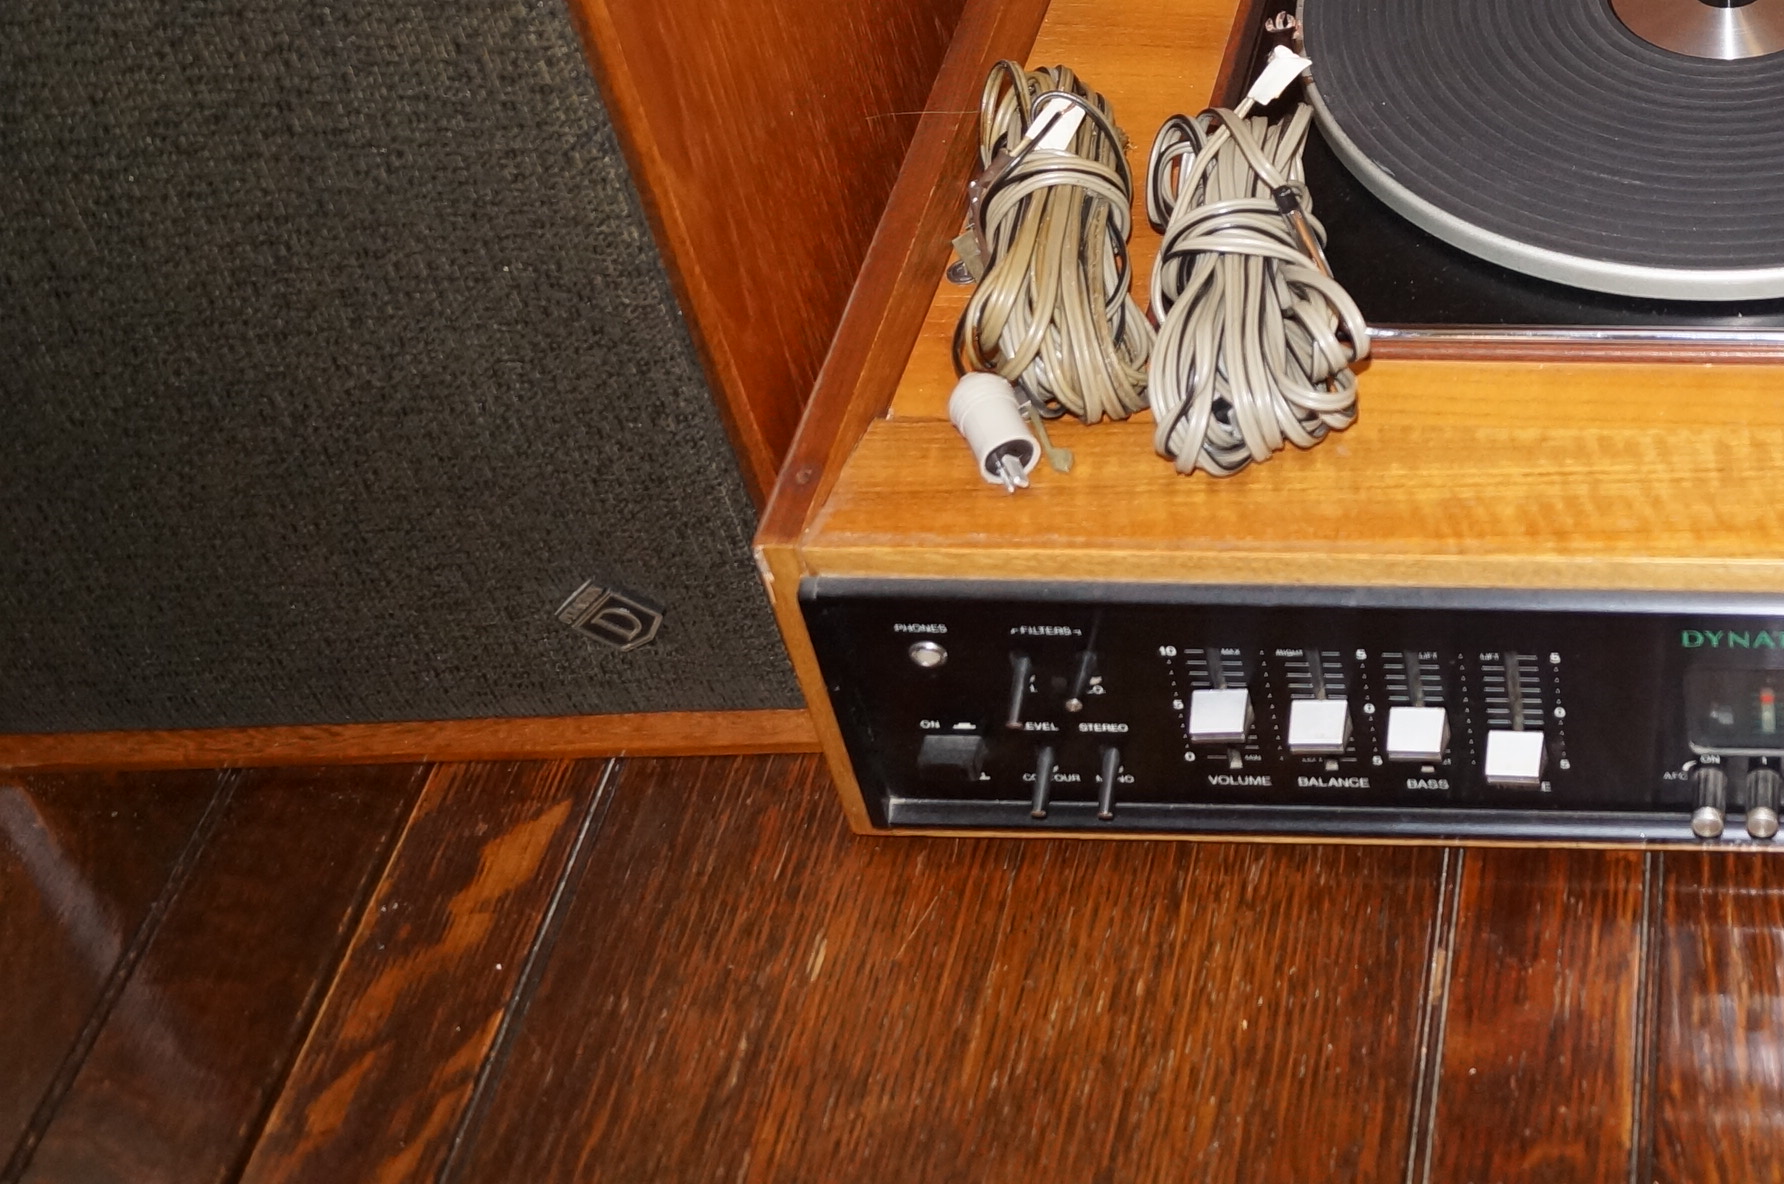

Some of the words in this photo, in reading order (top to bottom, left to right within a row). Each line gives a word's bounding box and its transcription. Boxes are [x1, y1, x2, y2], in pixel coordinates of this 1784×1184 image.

[893, 622, 948, 634] PHONES
[1019, 626, 1073, 636] FILTERS
[1158, 645, 1177, 657] 10
[919, 719, 941, 729] ON
[1023, 721, 1059, 731] EVEL
[1078, 722, 1129, 733] STEREO
[1022, 773, 1081, 783] COOUR
[1208, 774, 1272, 786] VOLUME
[1298, 776, 1370, 788] BALANCE
[1406, 778, 1450, 790] BASS
